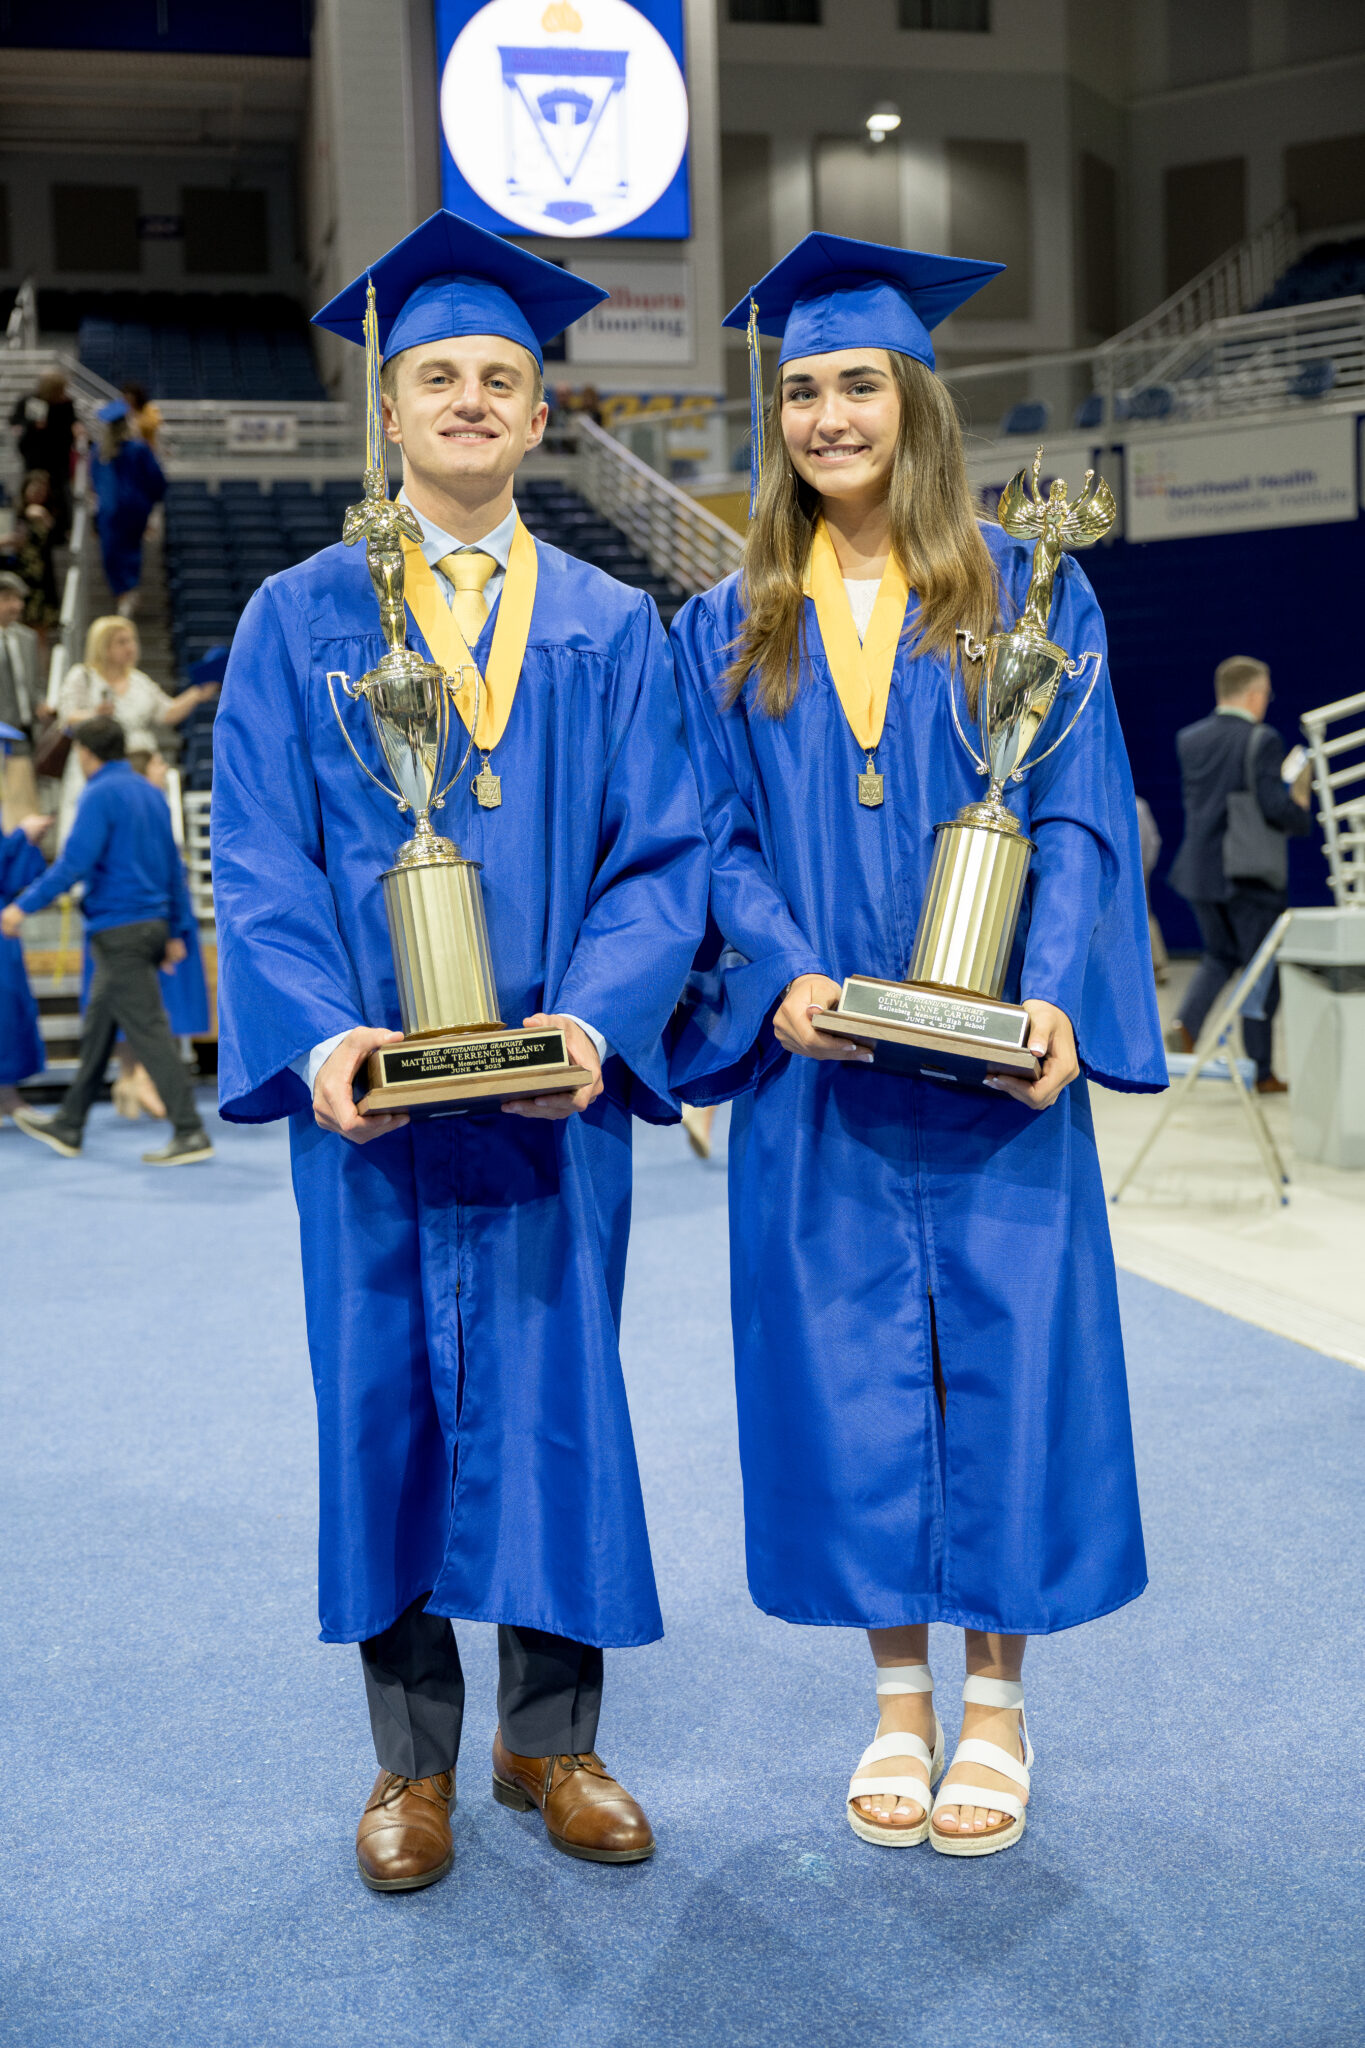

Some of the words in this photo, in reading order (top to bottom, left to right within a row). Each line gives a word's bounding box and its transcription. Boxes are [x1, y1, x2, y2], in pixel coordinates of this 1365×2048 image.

[883, 991, 904, 999] MOST
[878, 996, 909, 1009] OLIVIA
[913, 1004, 939, 1015] ANNE
[944, 1009, 989, 1024] CARMODY
[905, 1016, 925, 1024] JUNE
[938, 1022, 956, 1030] 2023
[914, 1010, 943, 1022] Memorial
[946, 1017, 962, 1026] High
[964, 1021, 986, 1031] School
[401, 1055, 447, 1068] MATTHEW
[451, 1049, 502, 1061] TERRENCE
[507, 1043, 546, 1055] MEANEY
[423, 1049, 441, 1057] MOST
[443, 1044, 488, 1055] OUTSTANDING
[490, 1040, 524, 1049] GRADUATE
[421, 1063, 455, 1072] Kellenberg
[457, 1058, 487, 1067] Memorial
[508, 1053, 529, 1062] School
